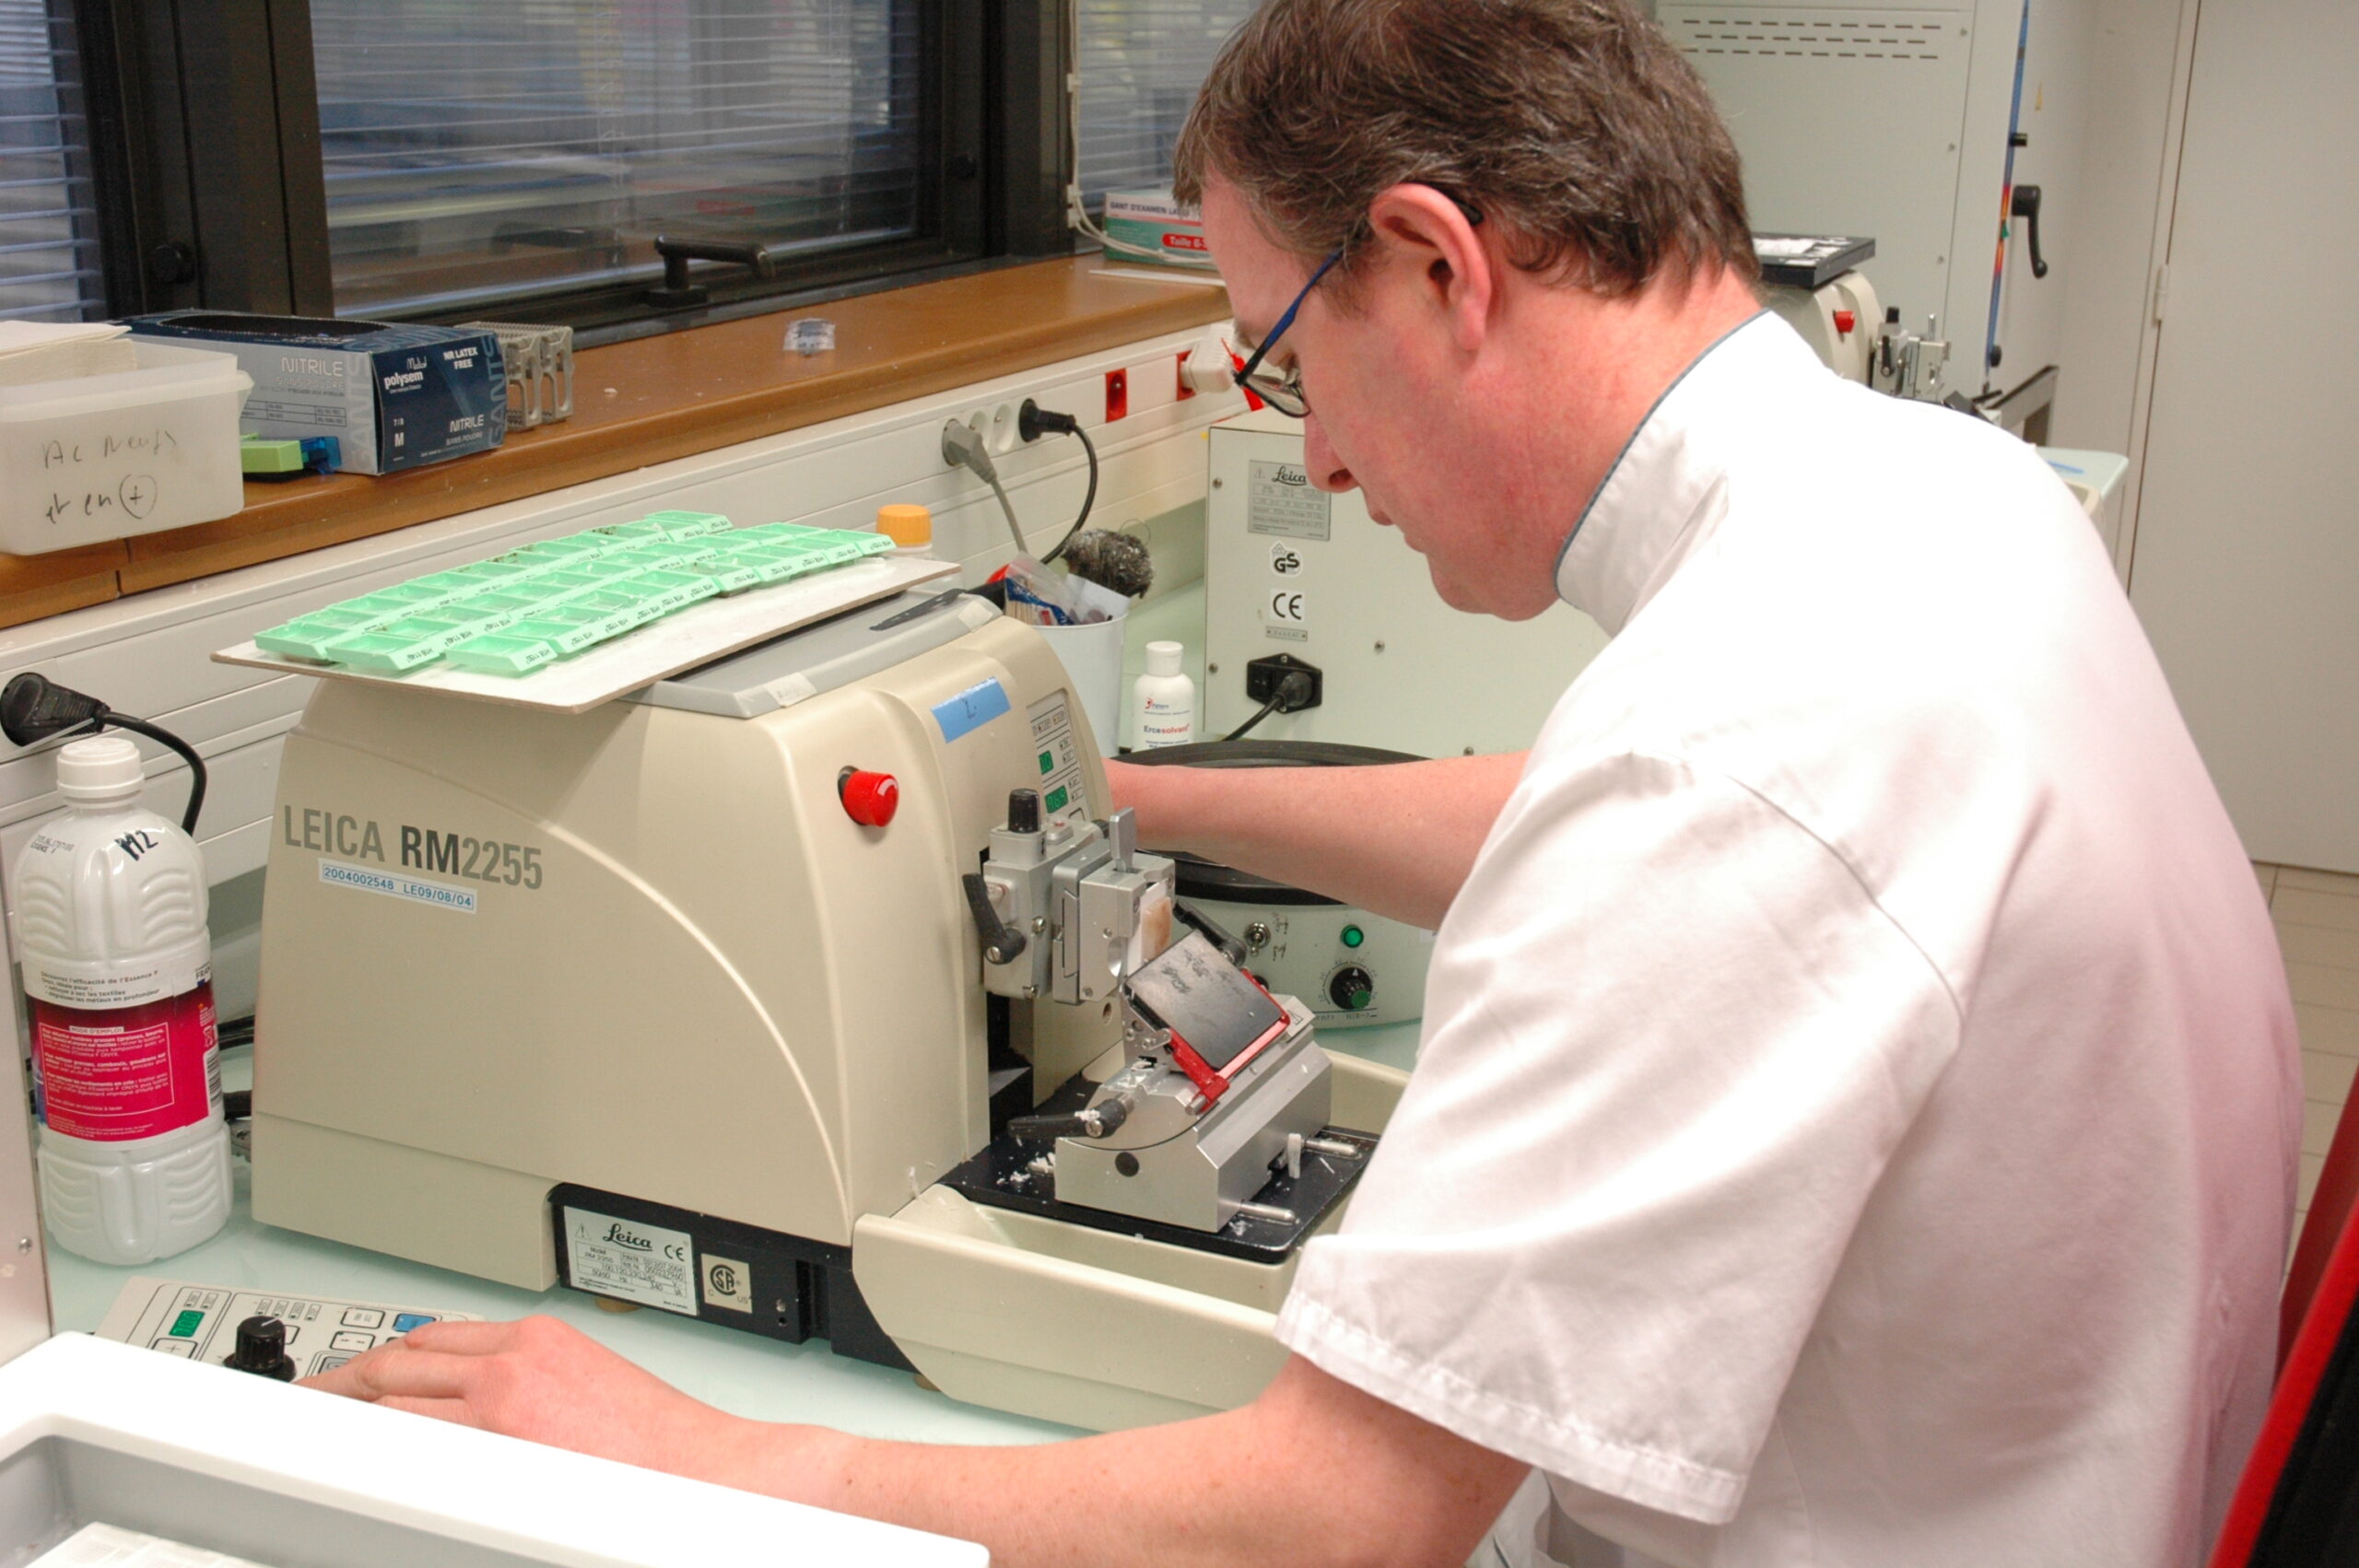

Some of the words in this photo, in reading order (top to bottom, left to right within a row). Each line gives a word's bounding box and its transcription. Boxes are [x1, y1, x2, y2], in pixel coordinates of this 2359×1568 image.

[455, 346, 478, 359] LATEX
[280, 357, 344, 378] NITRILE
[453, 358, 474, 370] FREE
[383, 370, 424, 390] polysem
[450, 414, 485, 433] NITRILE
[1272, 465, 1308, 486] Leica
[1273, 592, 1303, 621] CE
[284, 804, 385, 862] LEICA
[401, 825, 543, 890] RM2255
[323, 866, 394, 891] 2004002548
[403, 883, 473, 907] LE09/08/04
[602, 1223, 653, 1252] Leica
[664, 1245, 685, 1262] CE
